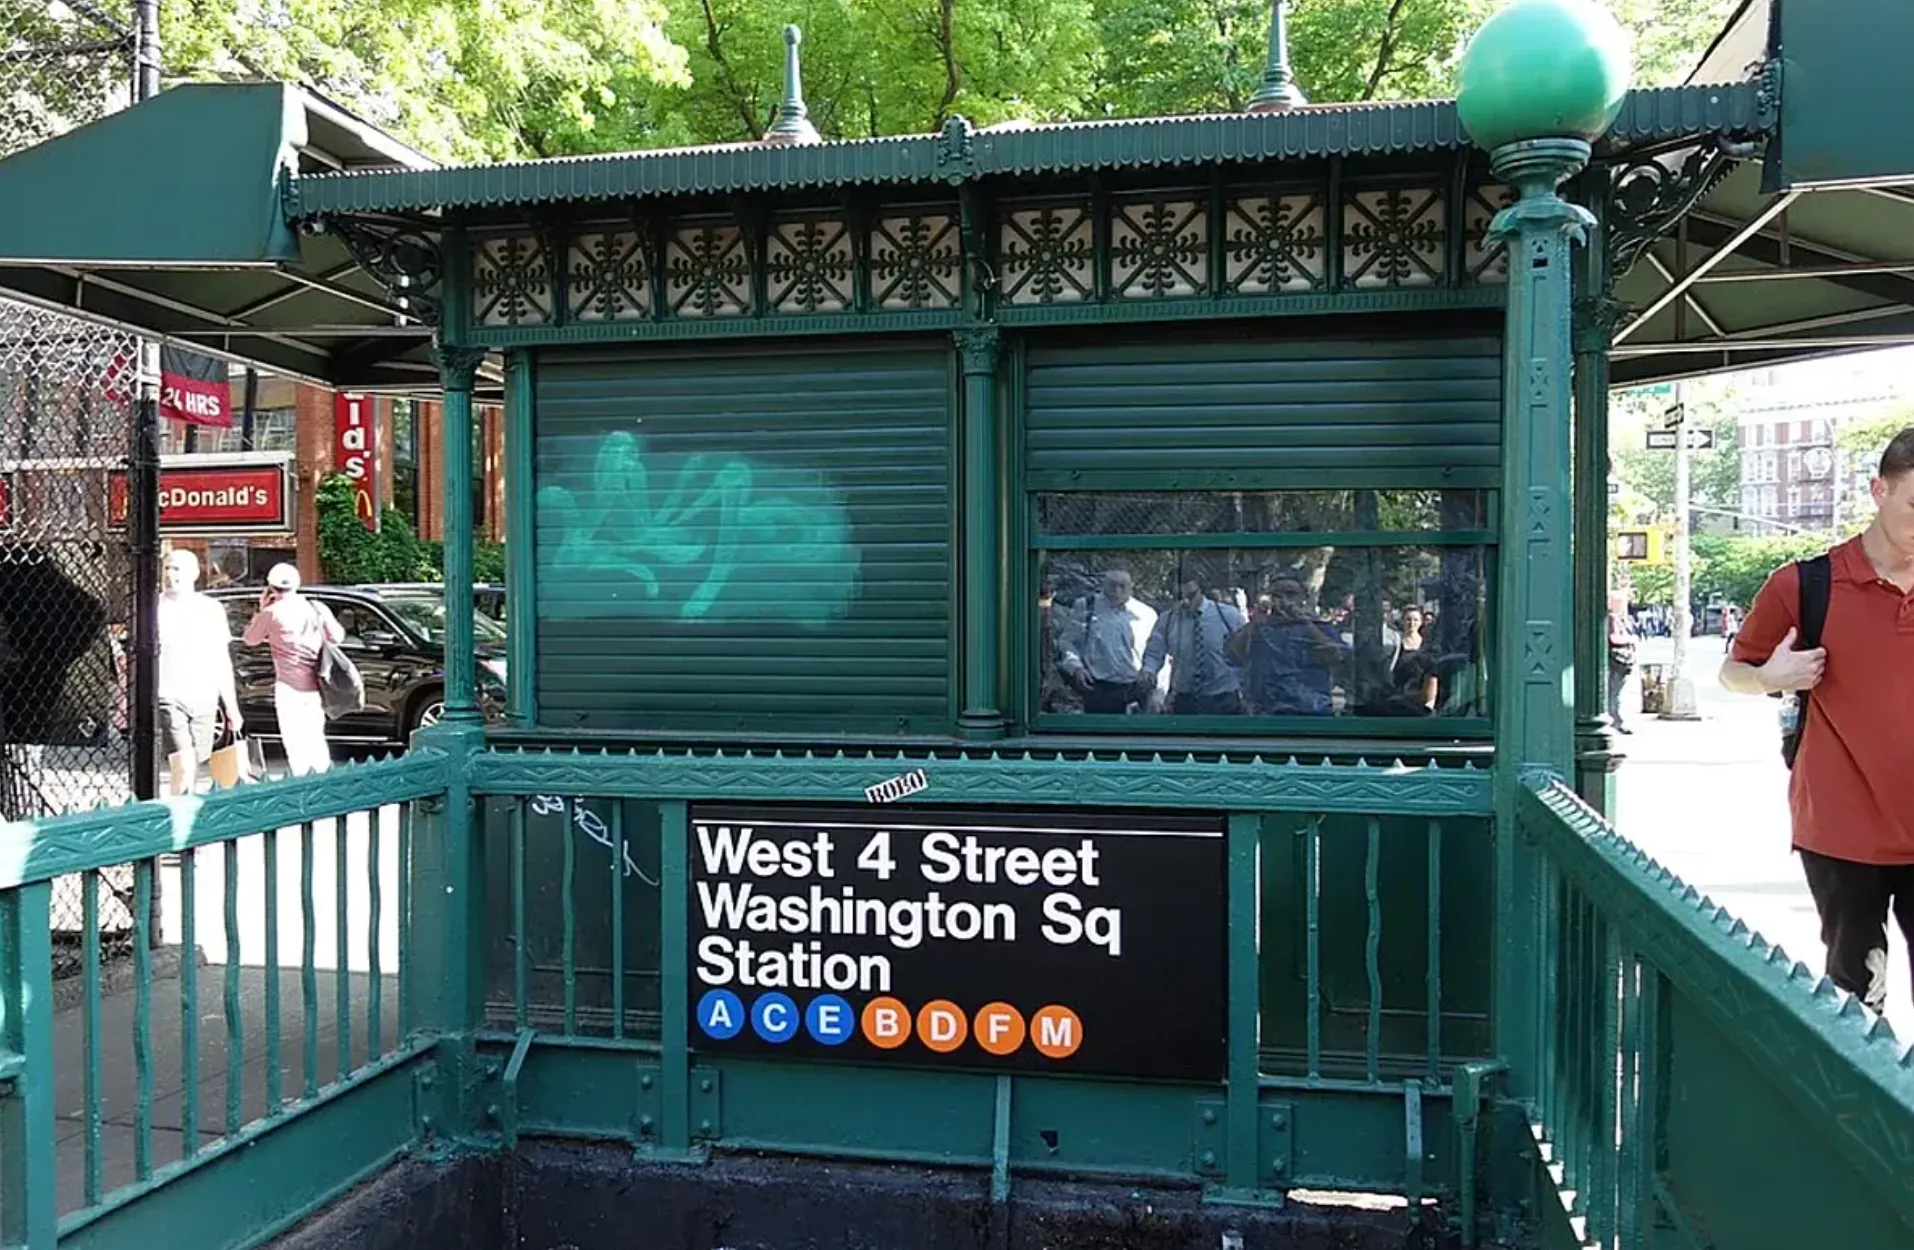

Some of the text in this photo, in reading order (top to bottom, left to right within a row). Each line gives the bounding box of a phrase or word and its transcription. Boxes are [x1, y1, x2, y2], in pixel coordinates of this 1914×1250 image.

[161, 387, 221, 416] 24 HRS
[342, 393, 371, 478] ld's
[158, 486, 268, 507] cDonald's
[696, 826, 835, 878] West
[857, 831, 896, 880] 4
[920, 832, 1099, 886] Street
[696, 881, 1121, 956] Washington Sq
[696, 935, 891, 992] Station
[709, 1000, 1072, 1047] A C E B D F M
